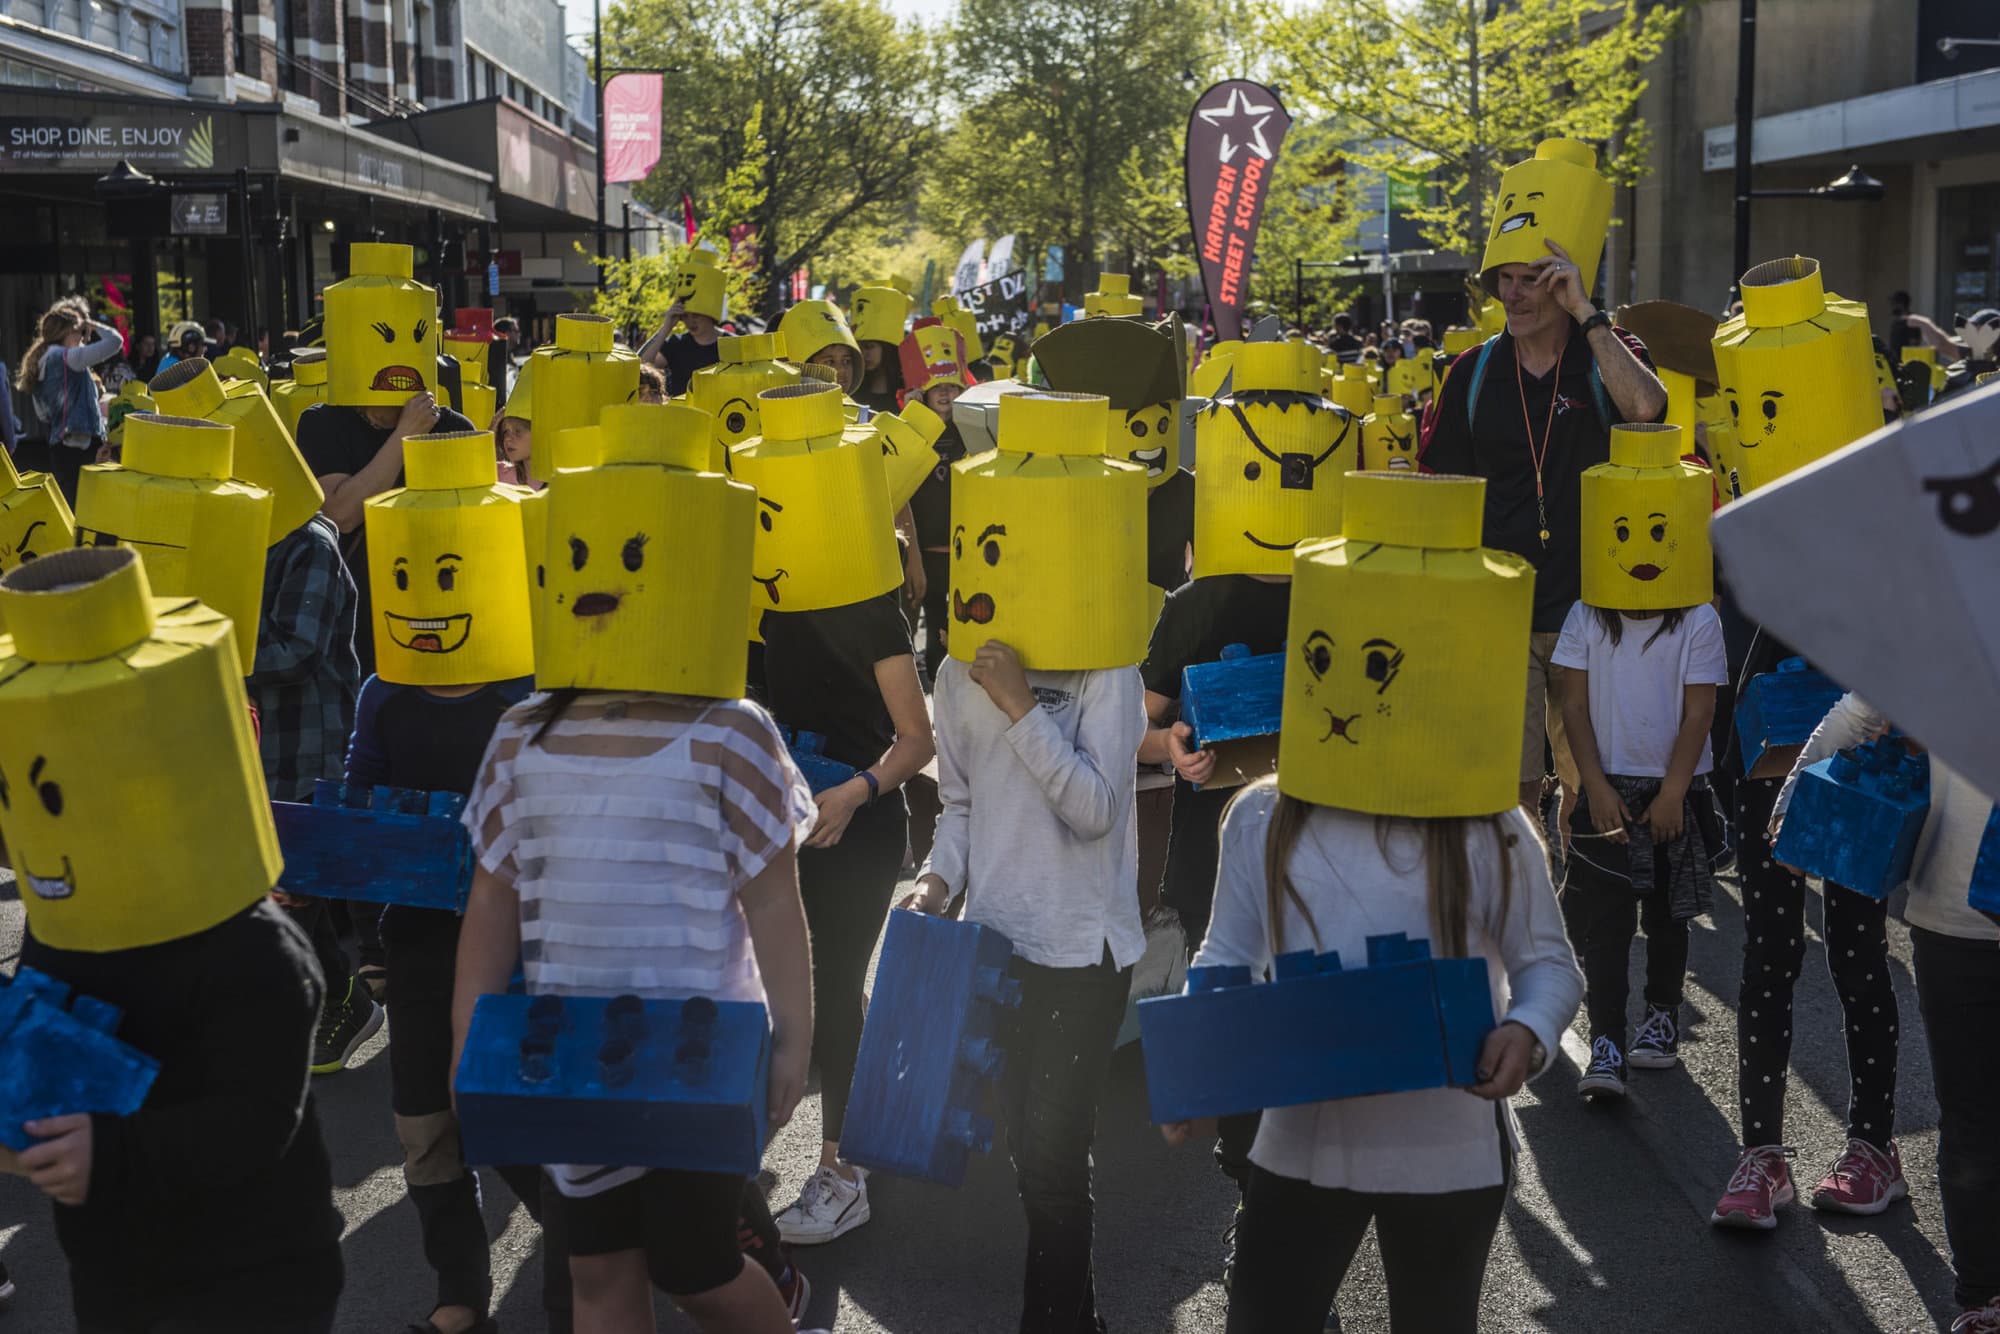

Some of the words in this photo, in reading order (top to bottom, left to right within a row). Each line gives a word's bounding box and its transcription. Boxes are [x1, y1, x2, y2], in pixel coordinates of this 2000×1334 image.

[11, 127, 63, 147] SHOP,
[68, 127, 117, 147] DINE,
[122, 127, 182, 145] ENJOY
[1202, 163, 1238, 264] HAMPDEN
[1219, 232, 1246, 307] STREET
[1233, 157, 1265, 231] SCHOOL
